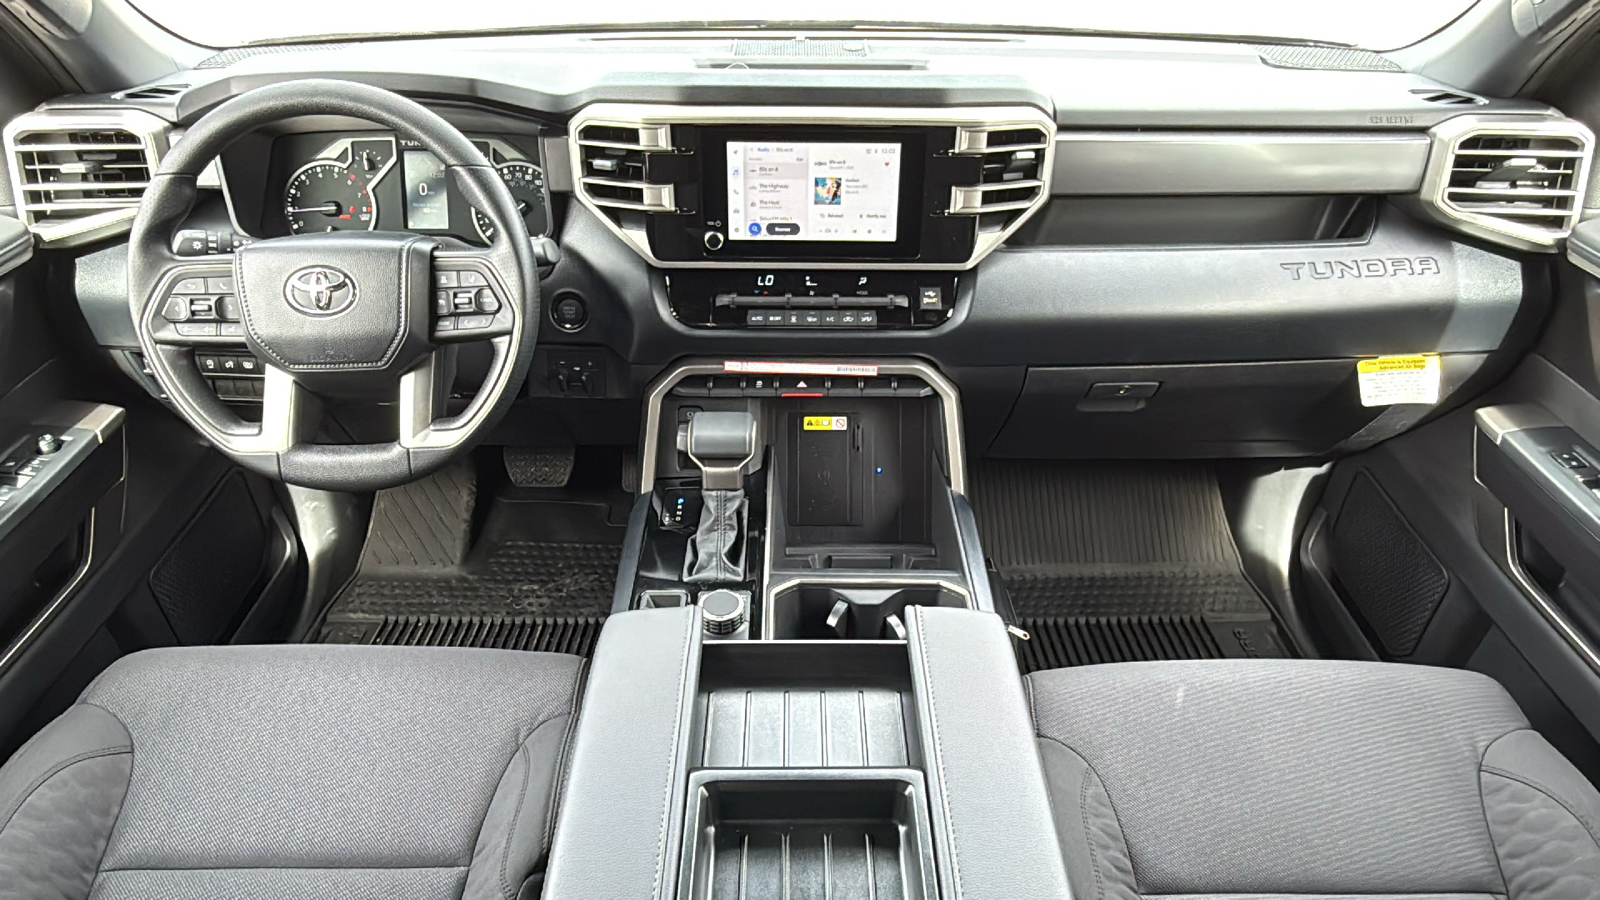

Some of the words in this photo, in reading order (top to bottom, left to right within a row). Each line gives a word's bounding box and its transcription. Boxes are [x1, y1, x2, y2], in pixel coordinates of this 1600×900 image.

[419, 182, 428, 196] 0
[1280, 257, 1440, 280] TUNDRA
[757, 274, 775, 286] LO
